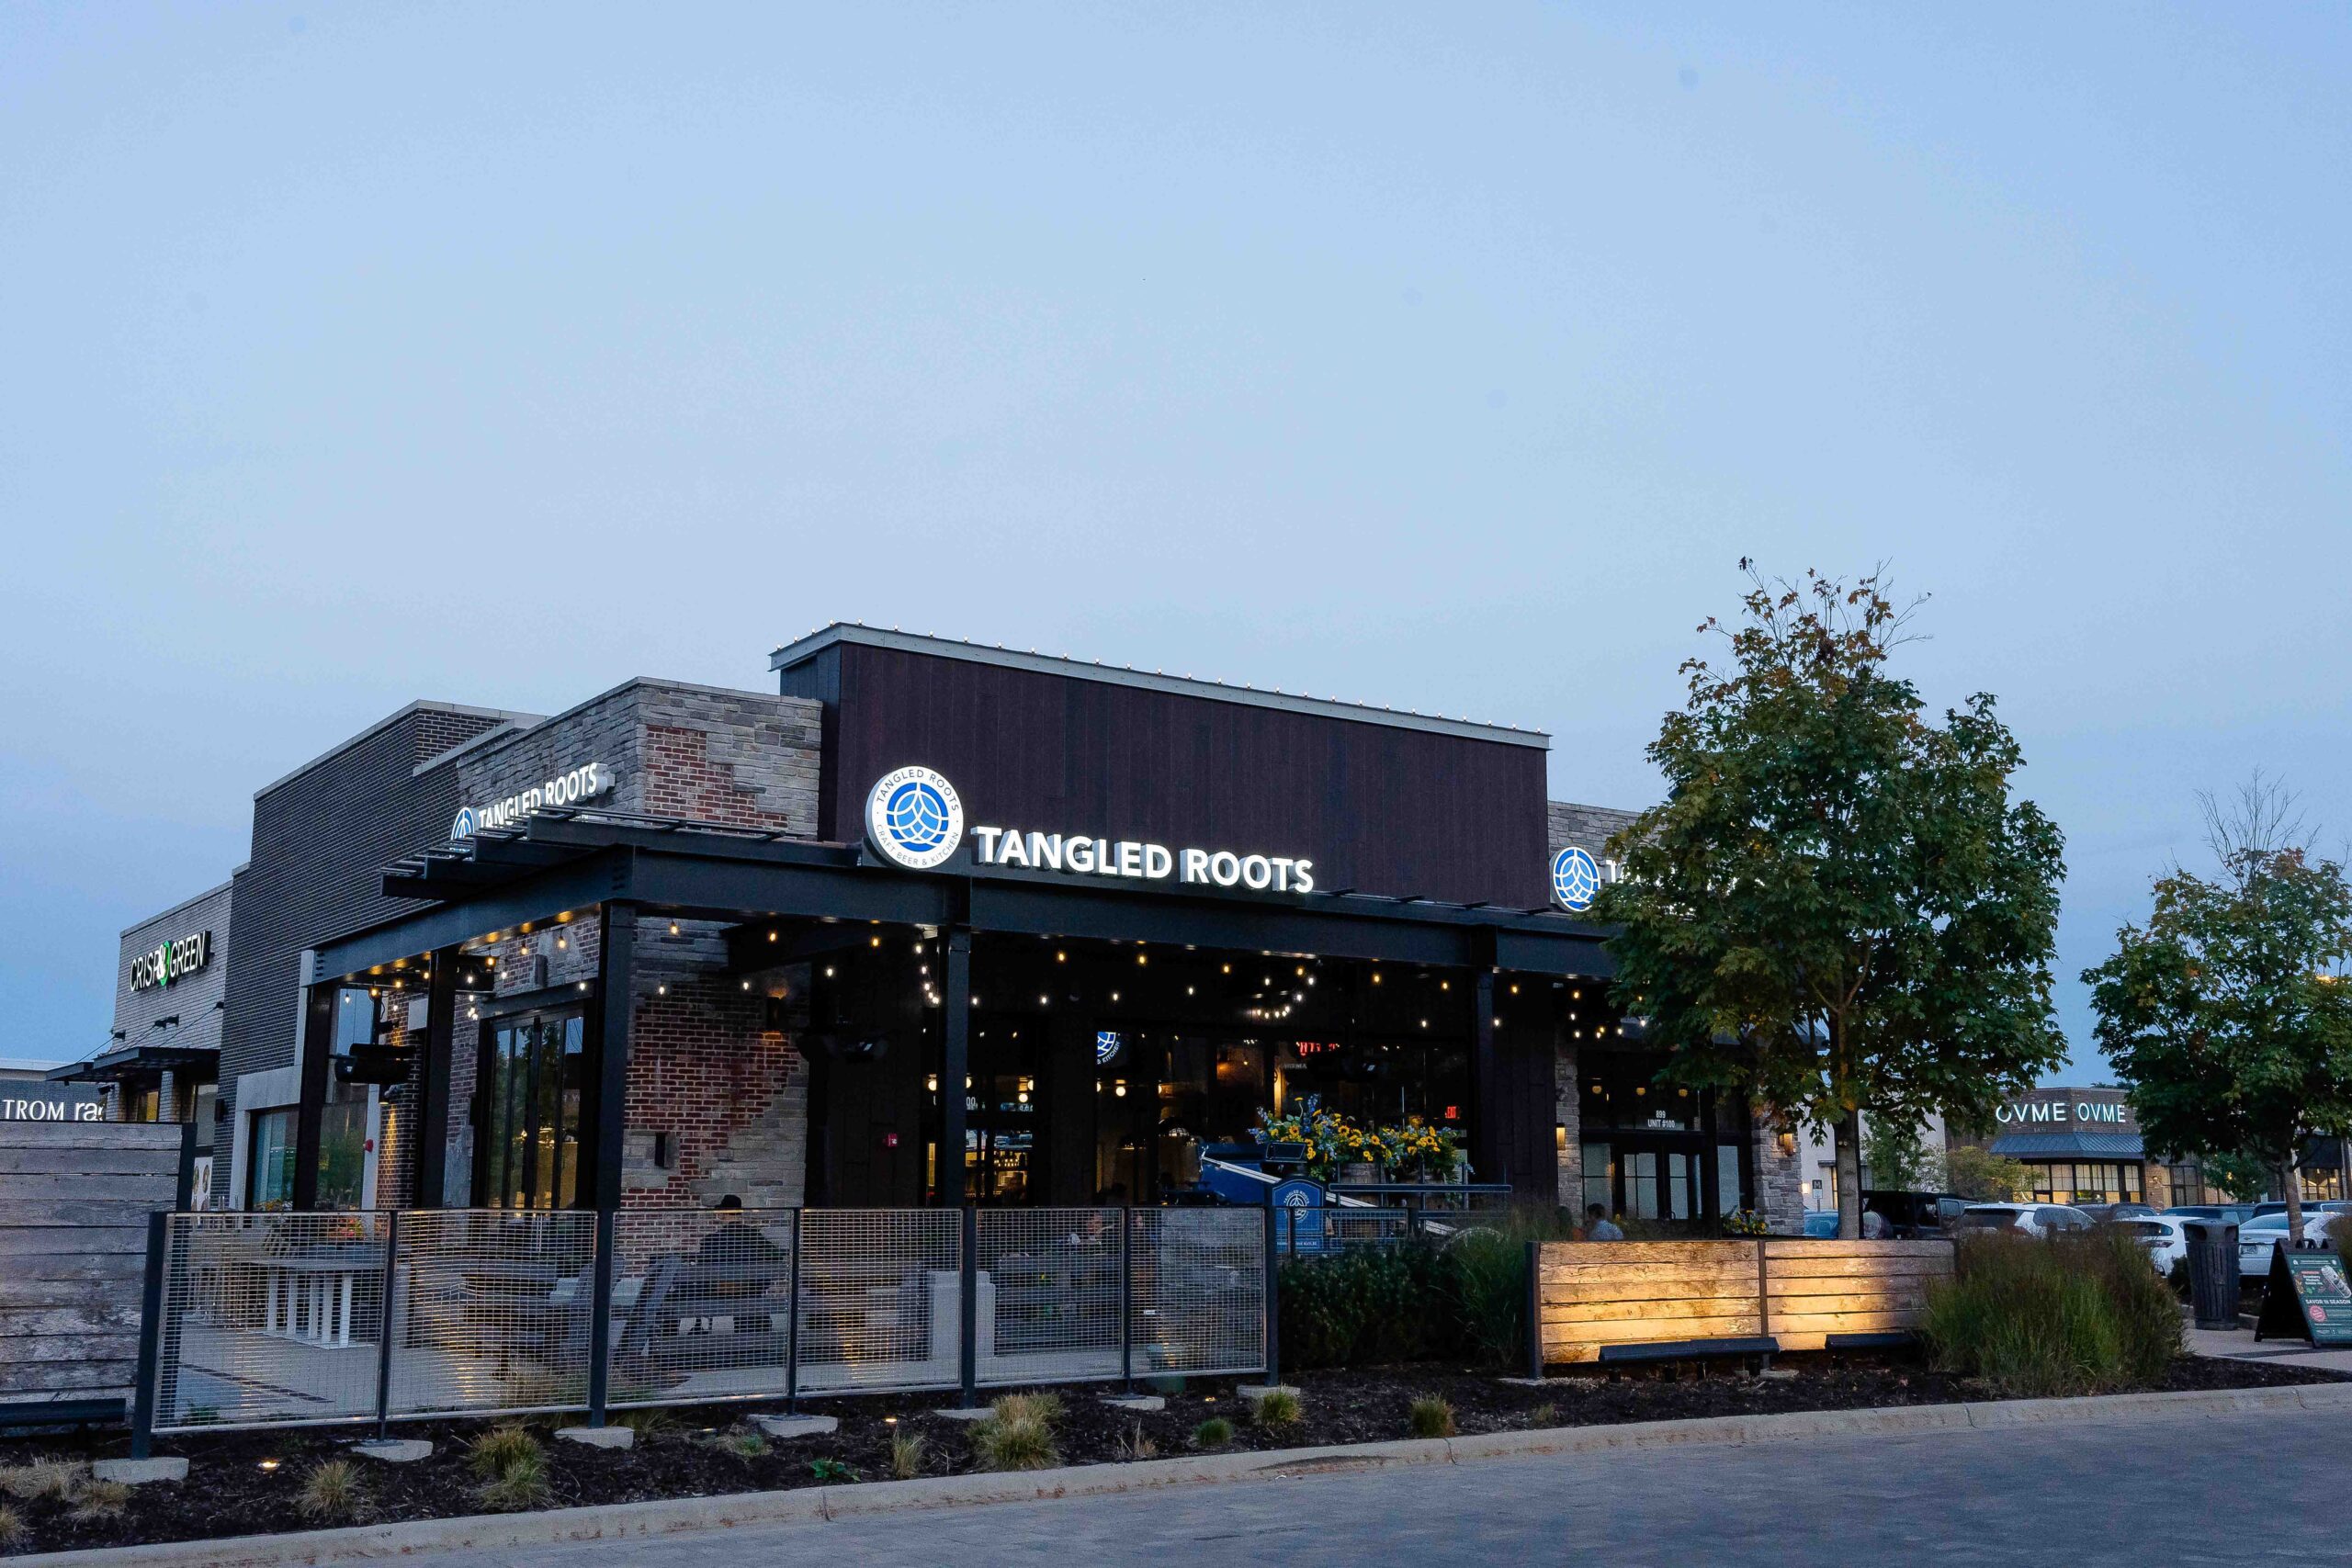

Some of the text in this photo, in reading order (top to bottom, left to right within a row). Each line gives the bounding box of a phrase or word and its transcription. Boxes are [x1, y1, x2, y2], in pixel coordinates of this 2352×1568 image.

[478, 762, 597, 828] TANGLED ROOTS
[876, 770, 960, 811] TANGLED ROOTS
[876, 824, 959, 866] CRAFT BEER & KITCHEN
[972, 826, 1314, 894] TANGLED ROOTS
[169, 930, 206, 977] GREEN
[3, 1100, 64, 1121] TROM
[1996, 1102, 2066, 1123] OVME
[2077, 1102, 2126, 1122] OVME
